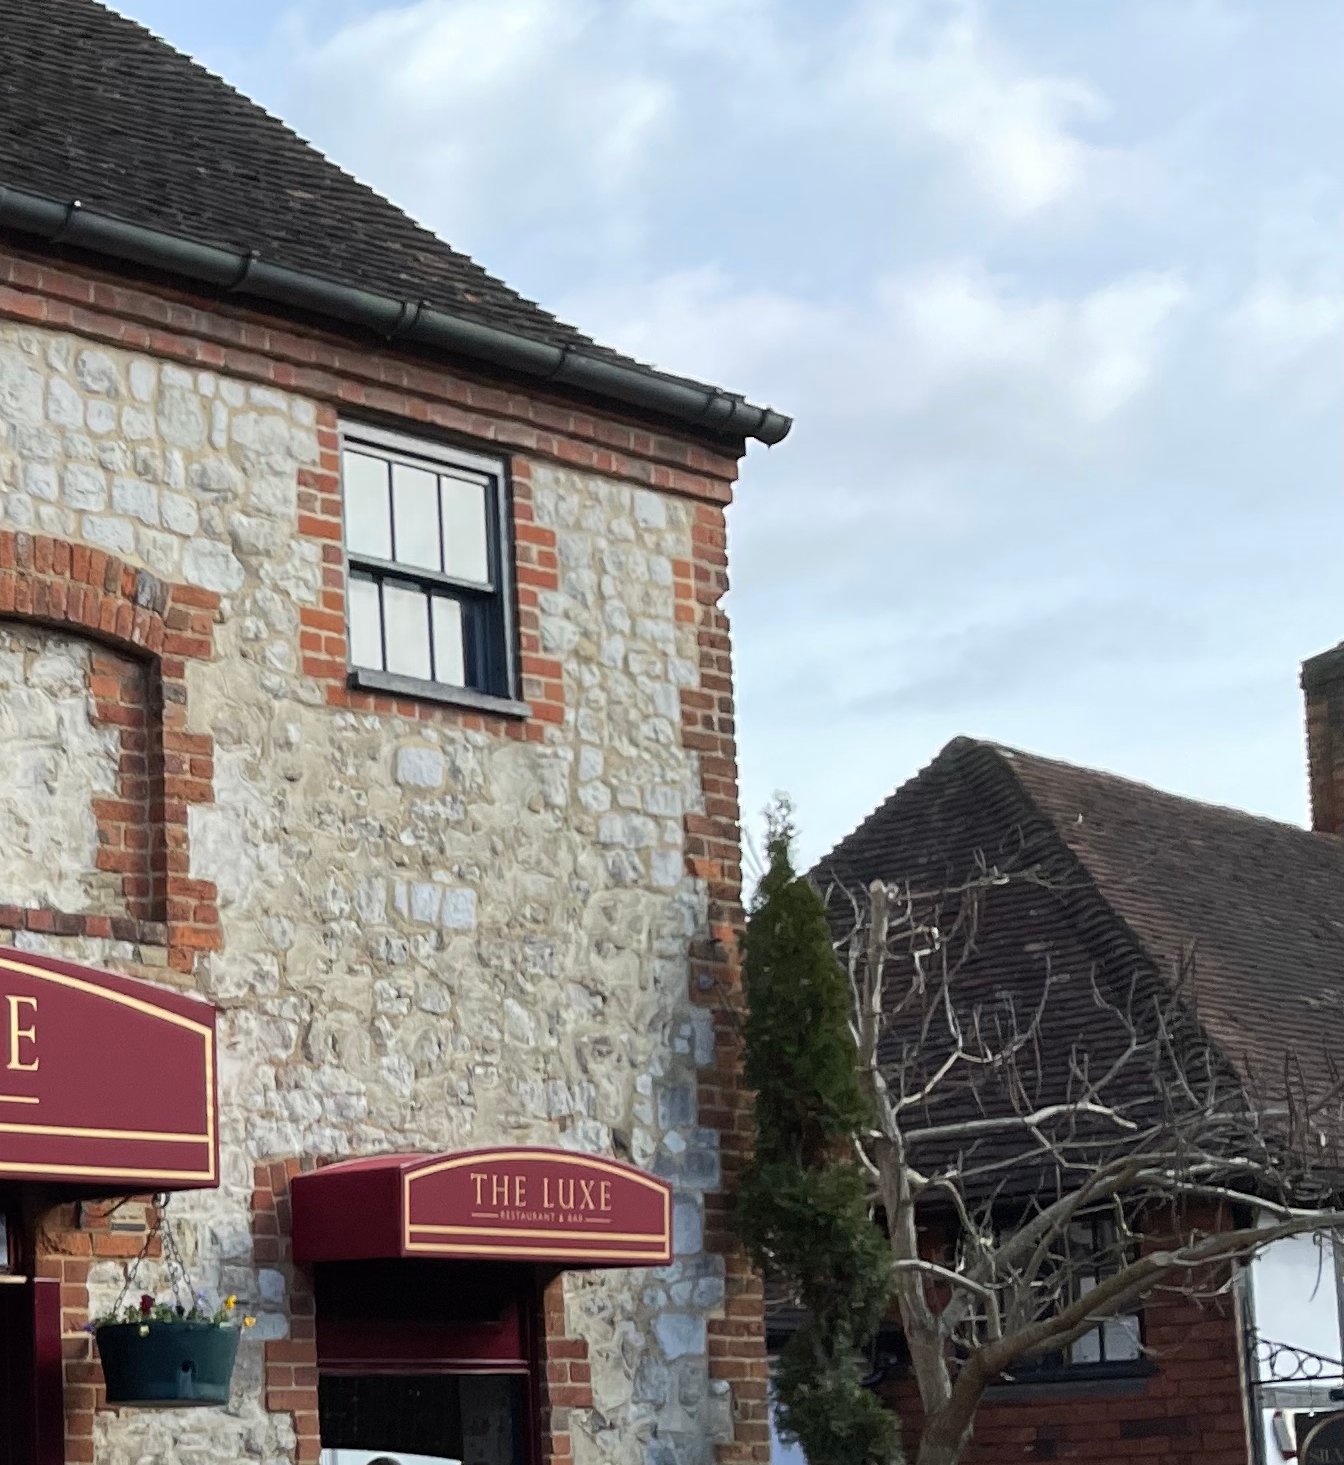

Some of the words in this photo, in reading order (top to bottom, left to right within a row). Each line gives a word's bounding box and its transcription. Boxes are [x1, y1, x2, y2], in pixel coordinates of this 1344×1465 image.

[470, 1172, 527, 1208] THE
[543, 1177, 612, 1212] LUXE
[500, 1210, 555, 1223] RESTAURANT
[558, 1213, 564, 1223] &
[567, 1213, 583, 1223] BAR
